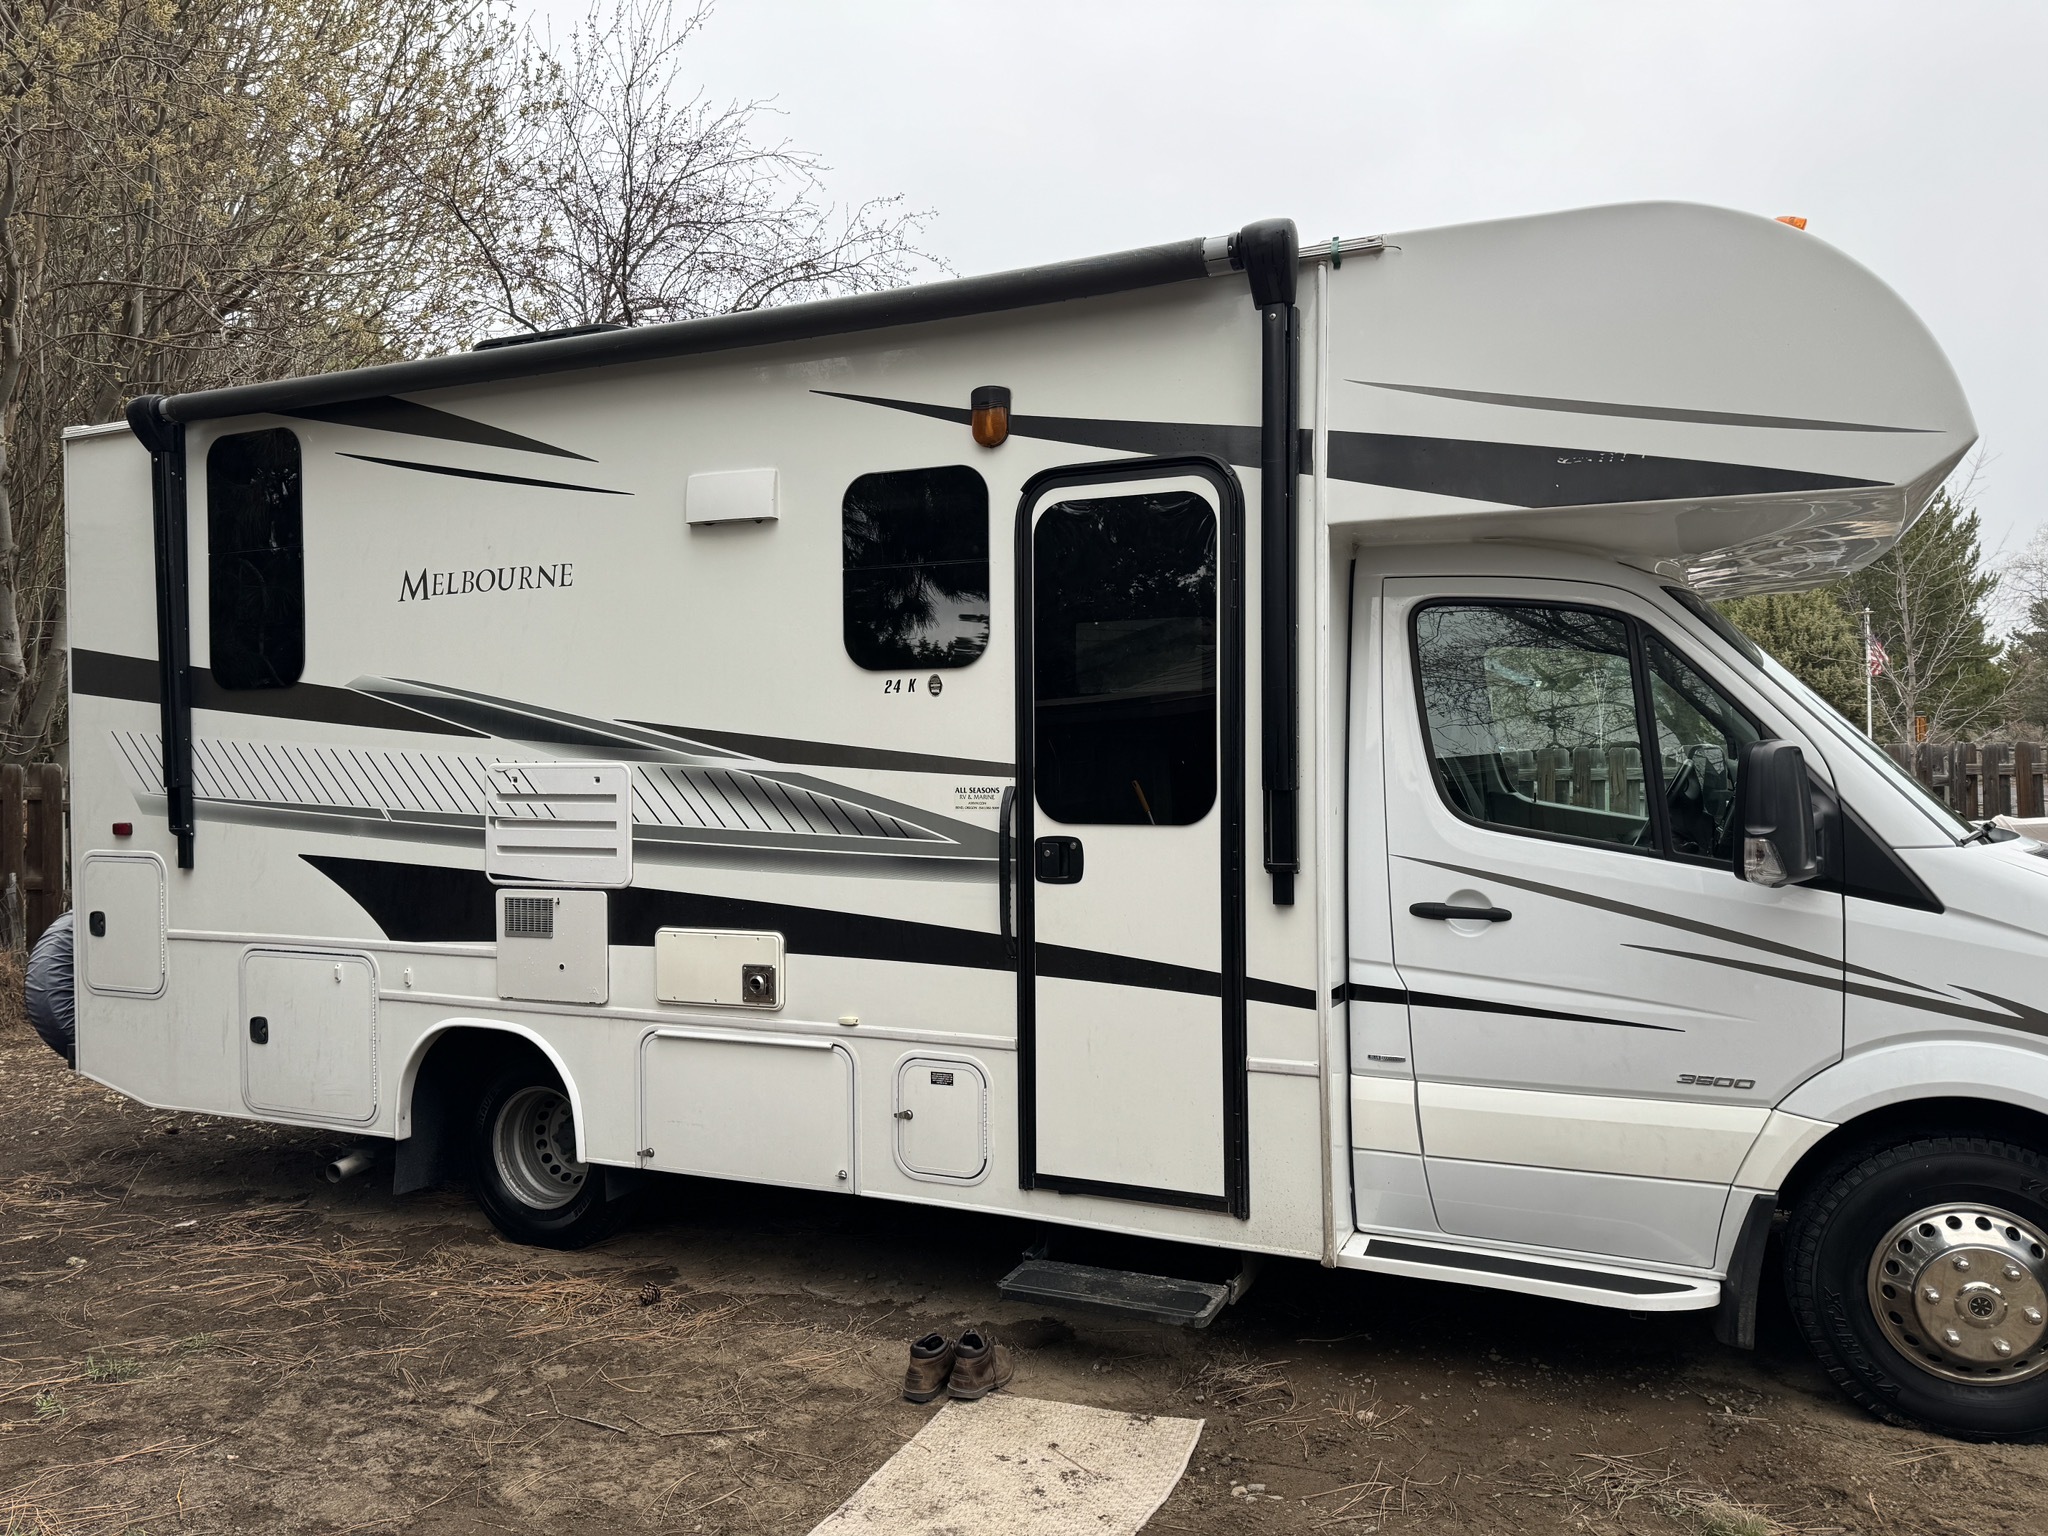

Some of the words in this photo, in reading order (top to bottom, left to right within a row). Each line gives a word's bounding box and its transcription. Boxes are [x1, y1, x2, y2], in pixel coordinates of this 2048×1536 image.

[398, 563, 574, 602] MELBOURNE
[884, 679, 901, 694] 24
[908, 678, 917, 693] K
[1676, 1073, 1756, 1090] 3500
